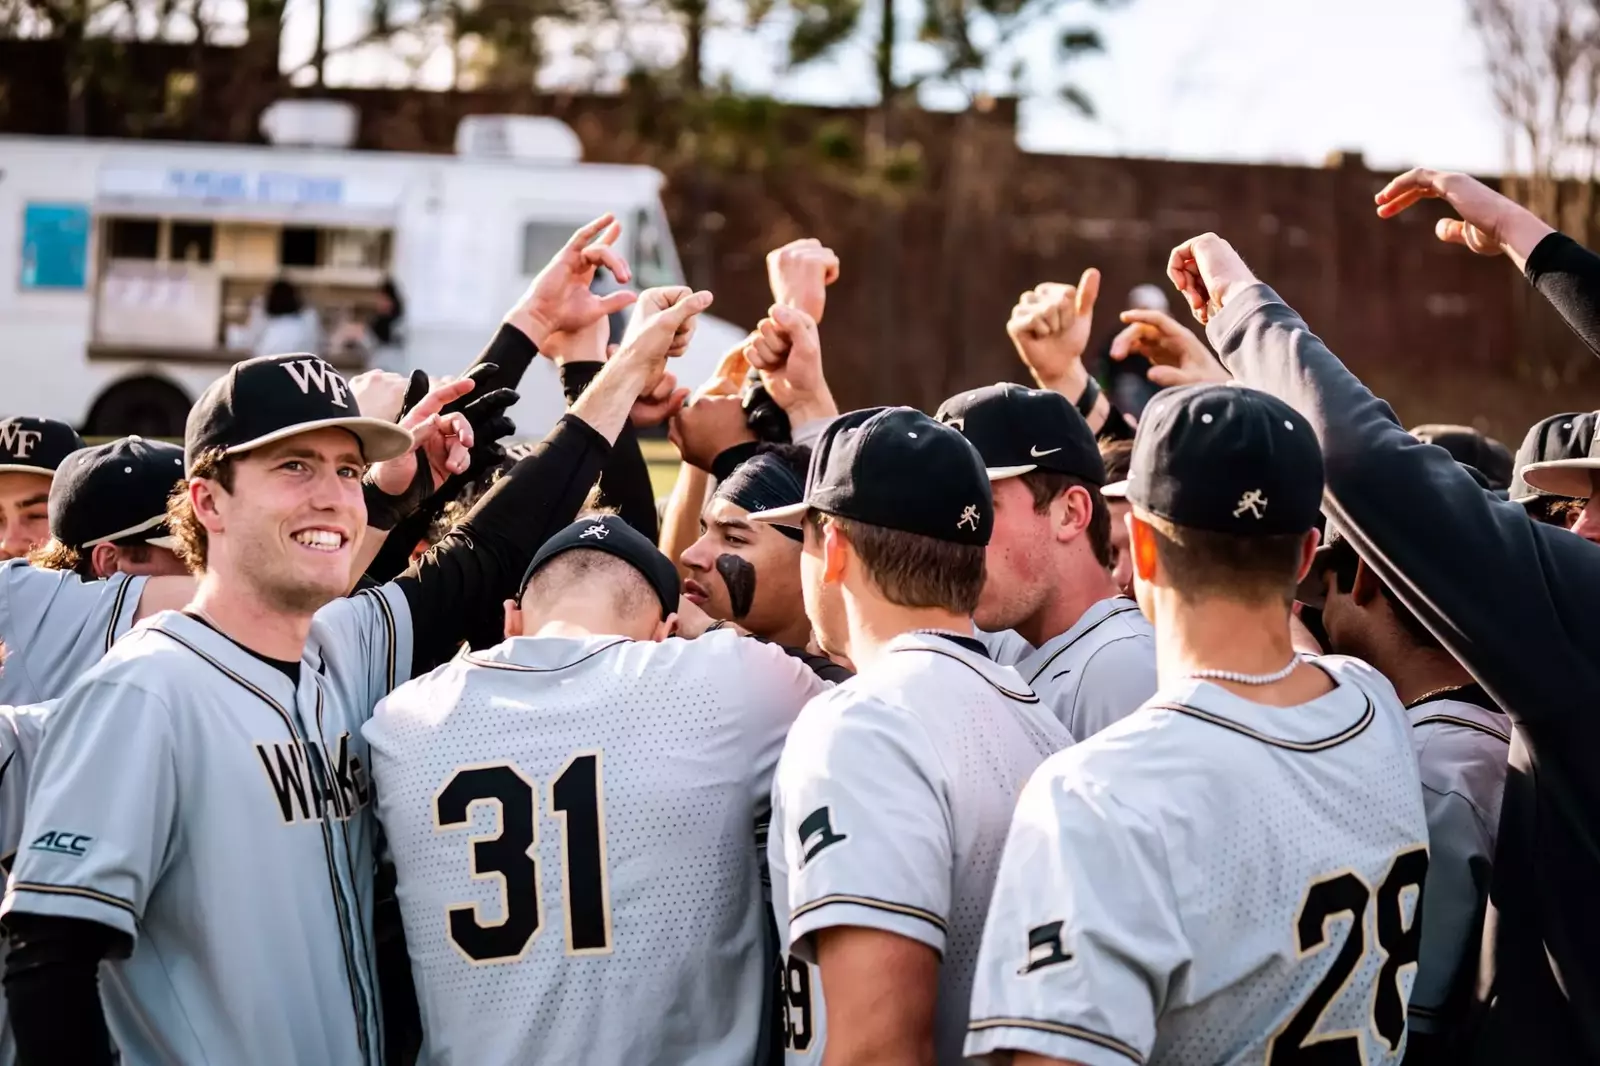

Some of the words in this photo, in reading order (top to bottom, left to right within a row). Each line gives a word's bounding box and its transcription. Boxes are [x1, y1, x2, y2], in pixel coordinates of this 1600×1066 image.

[279, 359, 349, 408] WF
[0, 421, 42, 458] WF
[32, 830, 93, 852] ACC
[433, 750, 612, 963] 31
[1264, 845, 1431, 1066] 28
